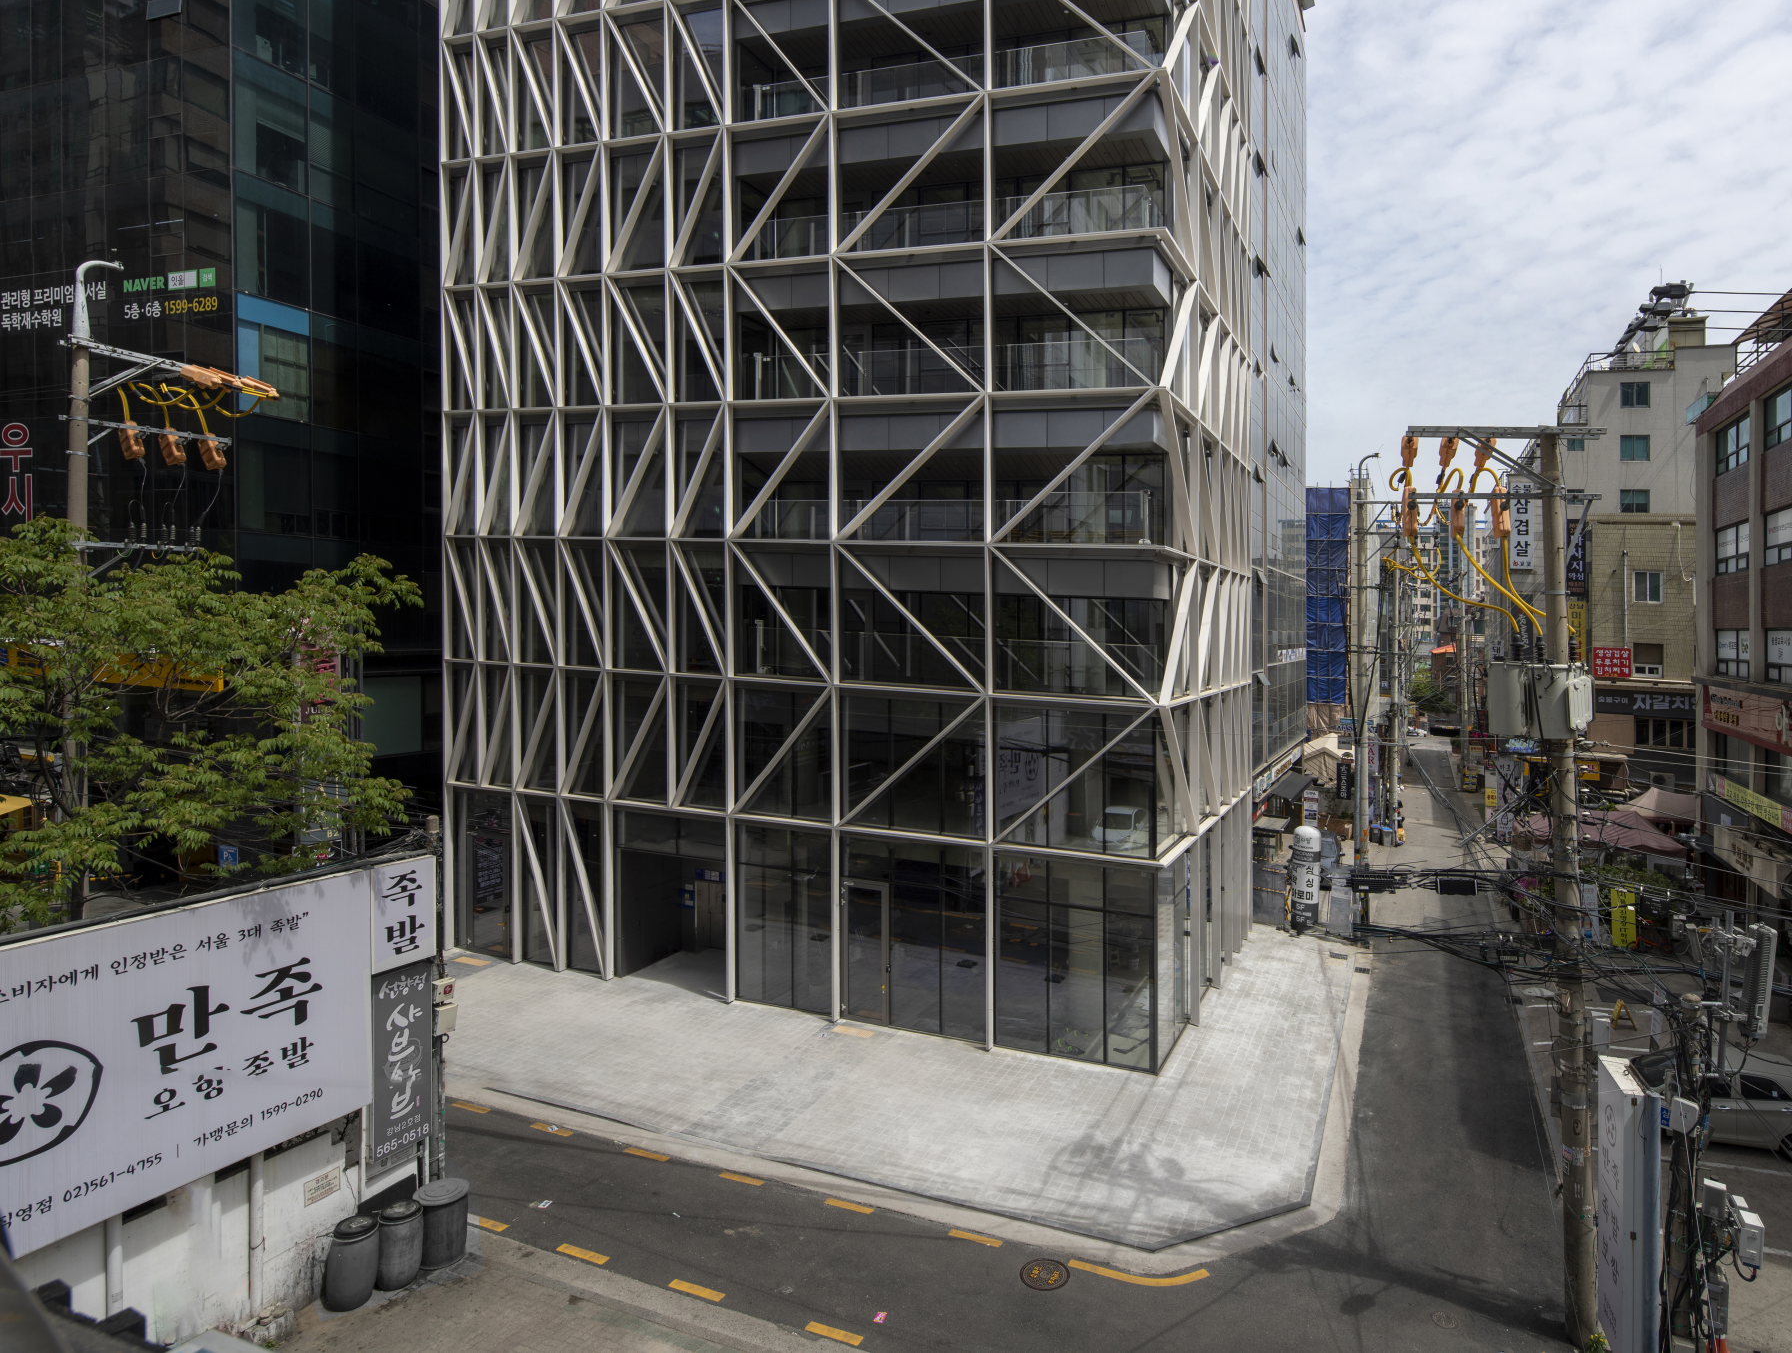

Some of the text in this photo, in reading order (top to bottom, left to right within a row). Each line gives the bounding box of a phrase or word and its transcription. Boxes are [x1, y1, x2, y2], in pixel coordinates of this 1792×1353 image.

[123, 276, 165, 293] NAVER
[202, 272, 213, 282] 검색
[1, 289, 31, 310] 관리형
[33, 285, 74, 305] 프리미엄
[164, 296, 218, 315] 1599-6289
[1, 308, 62, 331] 독학재수학원
[1513, 499, 1531, 557] 삼겹살
[1595, 649, 1630, 658] 생삼겹살
[1595, 658, 1629, 666] 두루치기
[1595, 666, 1629, 675] 김치찌개
[327, 829, 339, 838] B2
[381, 869, 425, 955] 족발
[110, 943, 187, 976] 인정받은
[195, 932, 231, 951] 서울
[238, 924, 262, 942] 3대
[131, 957, 323, 1075] 만족
[63, 1152, 163, 1203] 02)561-4755
[193, 1114, 253, 1147] 가맹문의
[260, 1087, 323, 1121] 1599-0290
[376, 1122, 430, 1158] 565-0518
